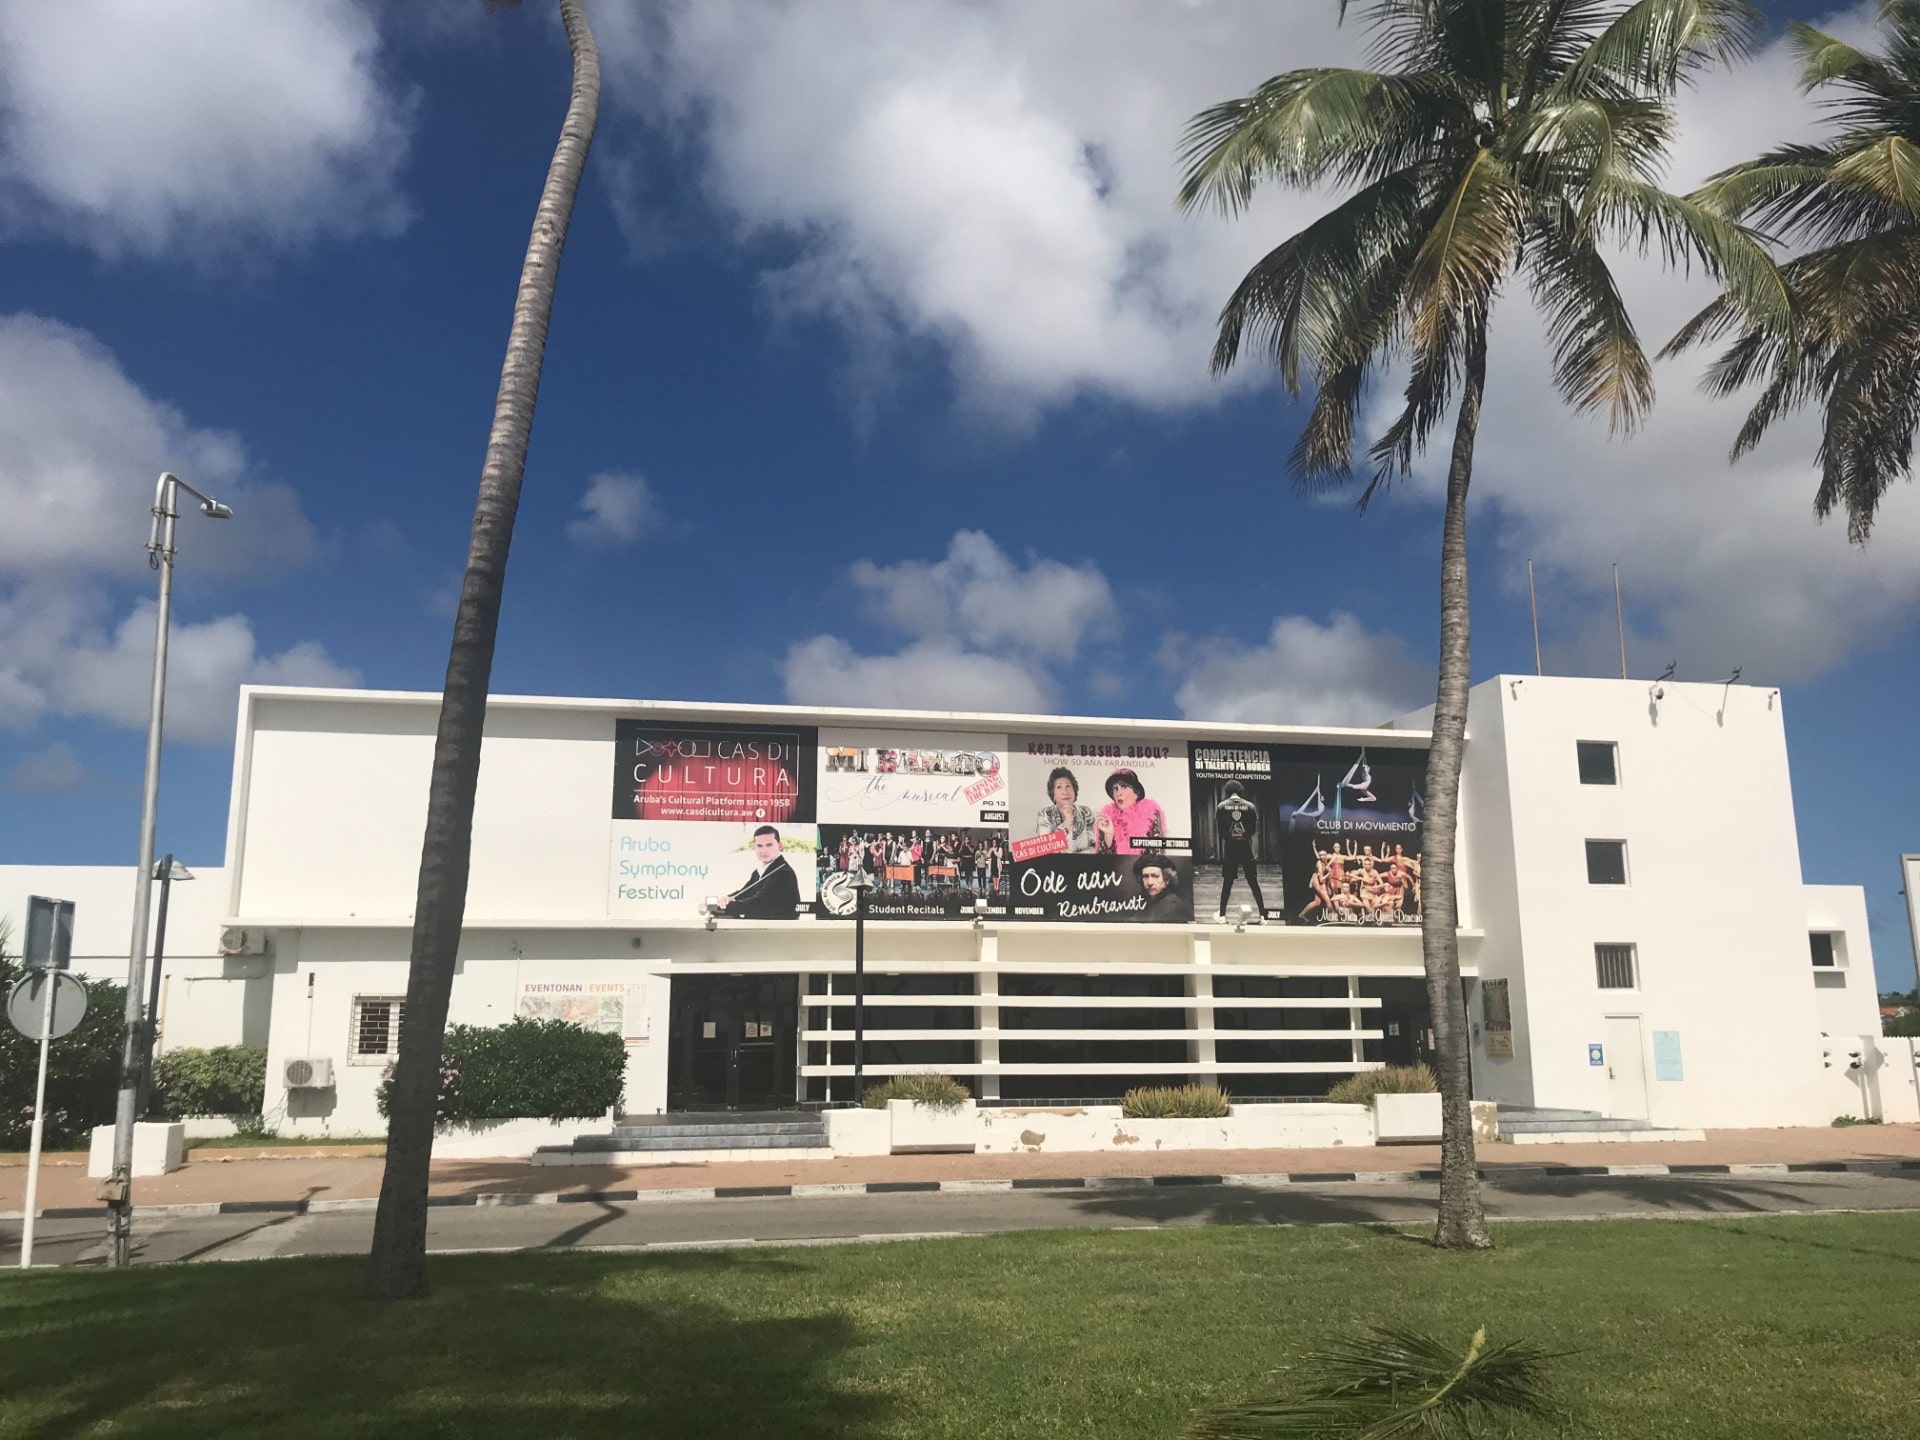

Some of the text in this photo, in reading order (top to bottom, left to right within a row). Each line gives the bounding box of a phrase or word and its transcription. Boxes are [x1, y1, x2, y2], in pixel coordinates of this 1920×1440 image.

[718, 741, 789, 760] CAS DI
[1194, 748, 1271, 763] COMPETENCIA
[1043, 757, 1069, 766] SHOW
[1105, 759, 1155, 768] FARANDULA
[1204, 761, 1235, 771] TALENTO
[1236, 762, 1246, 771] PA
[633, 763, 790, 787] CULTURA
[965, 776, 998, 796] RAISING
[633, 794, 790, 807] Aruba's Cultural Platform since 1958
[893, 785, 963, 806] musical
[660, 807, 753, 817] www.casdicultura.aw
[984, 812, 1005, 821] AUGUST
[1316, 819, 1416, 832] CLUB DI MOVIMIENTO
[620, 836, 671, 852] Aruba
[1020, 836, 1047, 849] presenta
[1132, 839, 1162, 847] SEPTEMBER
[1166, 840, 1189, 848] OCTOBER
[1015, 840, 1066, 859] CAS DI CULTURA
[619, 859, 709, 879] Symphony
[1020, 868, 1122, 896] Ode aan
[618, 884, 684, 900] Festival
[795, 904, 810, 912] JULY
[868, 904, 906, 914] Student
[907, 904, 945, 915] Recitals
[960, 906, 1007, 914] JUNE CEMBER
[1014, 906, 1044, 915] NOVEMBER
[1057, 895, 1147, 917] Rembrandt
[1267, 911, 1280, 919] JULY
[525, 983, 625, 993] EVENTONAN EVENTS
